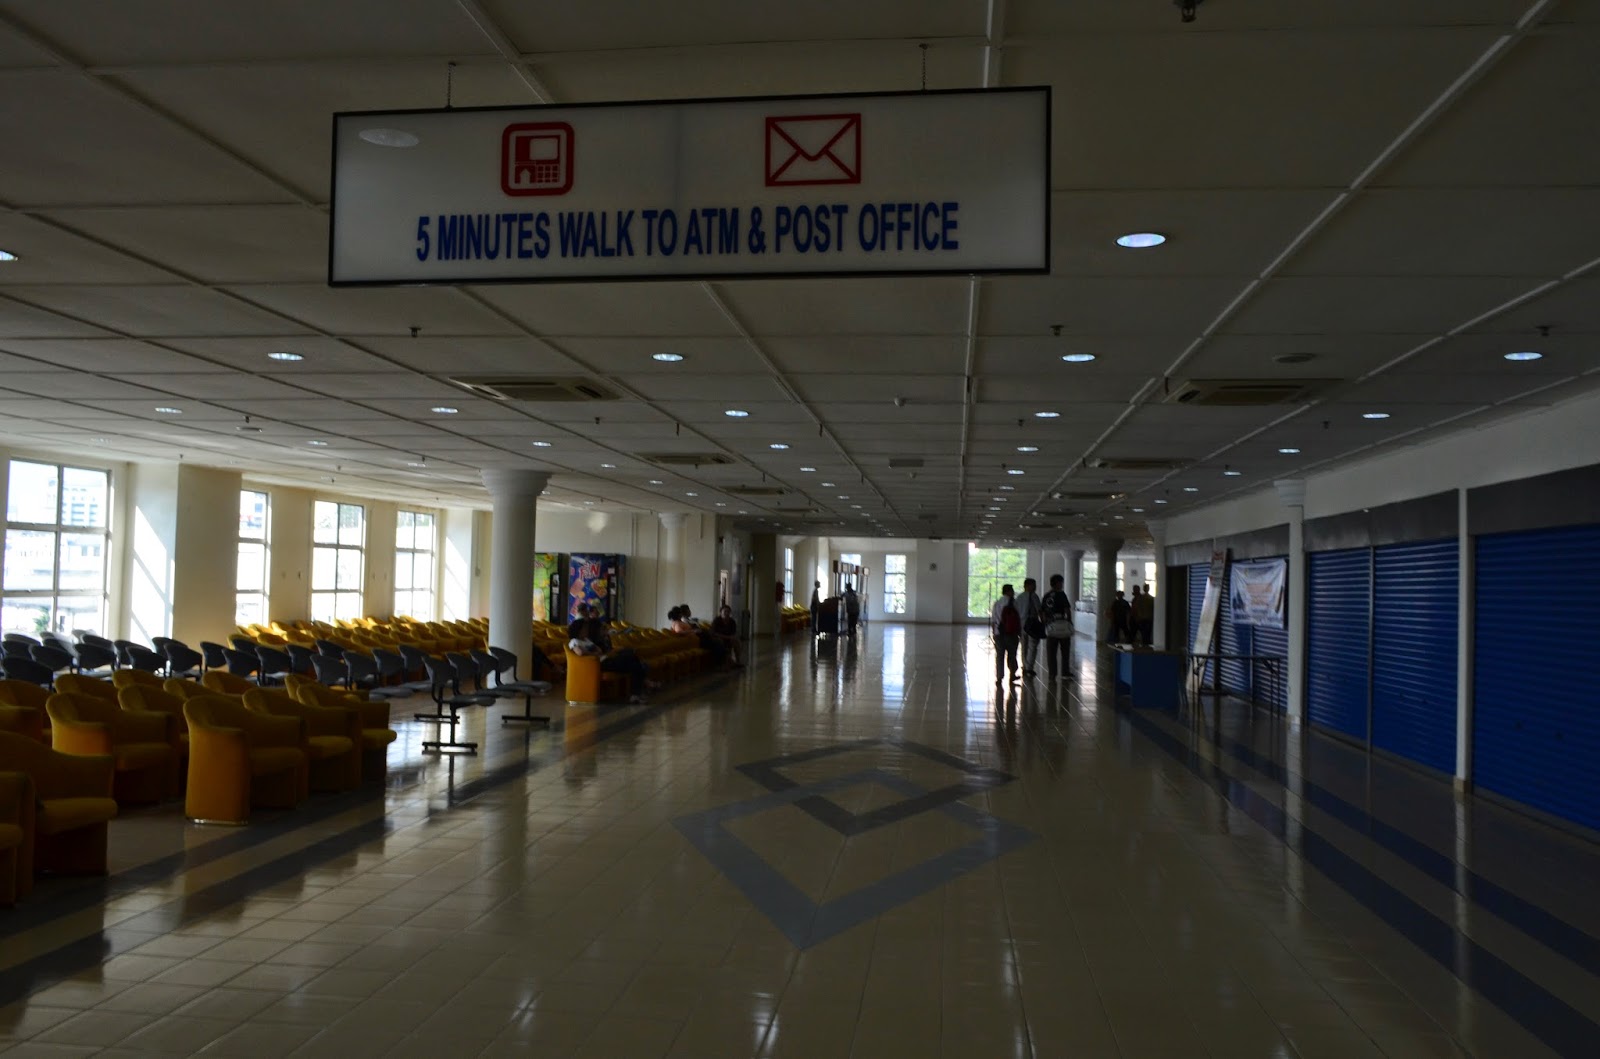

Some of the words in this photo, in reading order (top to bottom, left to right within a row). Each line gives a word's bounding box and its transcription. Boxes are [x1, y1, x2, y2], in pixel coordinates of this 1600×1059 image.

[416, 216, 430, 261] 5
[437, 212, 550, 260] MINUTES
[559, 211, 633, 257] WALK
[642, 209, 678, 256] TO
[684, 208, 739, 255] ATM
[748, 207, 766, 254] &
[776, 205, 848, 253] POST
[859, 202, 959, 251] OFFICE
